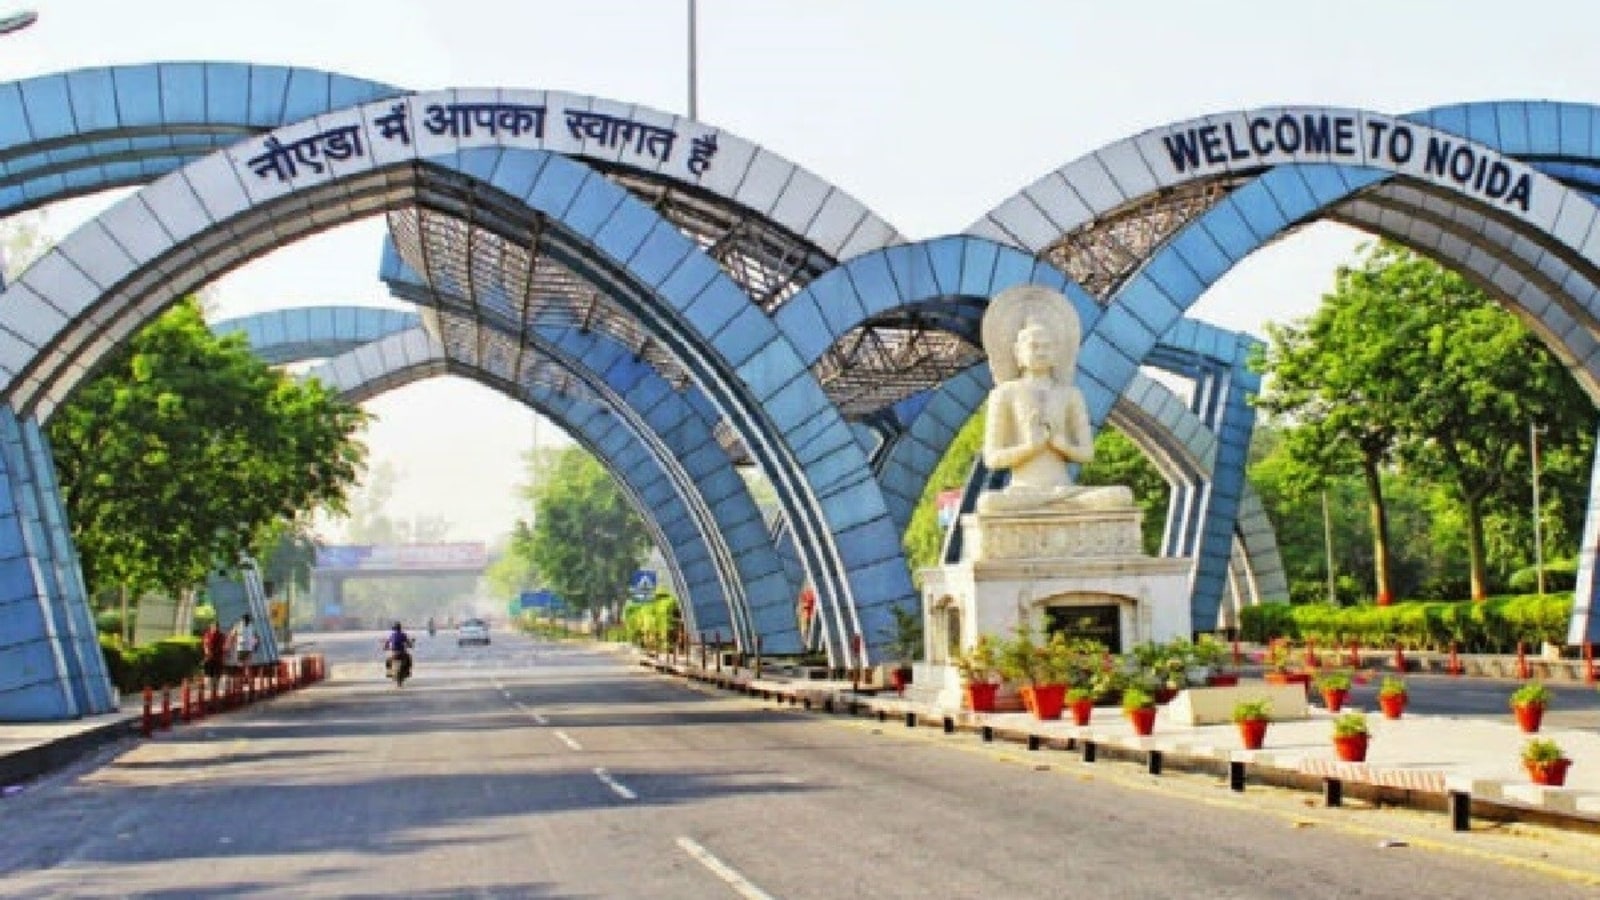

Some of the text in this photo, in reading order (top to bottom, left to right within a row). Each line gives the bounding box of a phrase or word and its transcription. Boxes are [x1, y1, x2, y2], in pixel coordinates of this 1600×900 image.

[248, 126, 362, 181] नौएडा
[423, 104, 547, 138] आपका
[564, 110, 677, 162] स्वागत
[687, 132, 718, 176] है
[1163, 114, 1532, 212] WELCOME TO NOIDA
